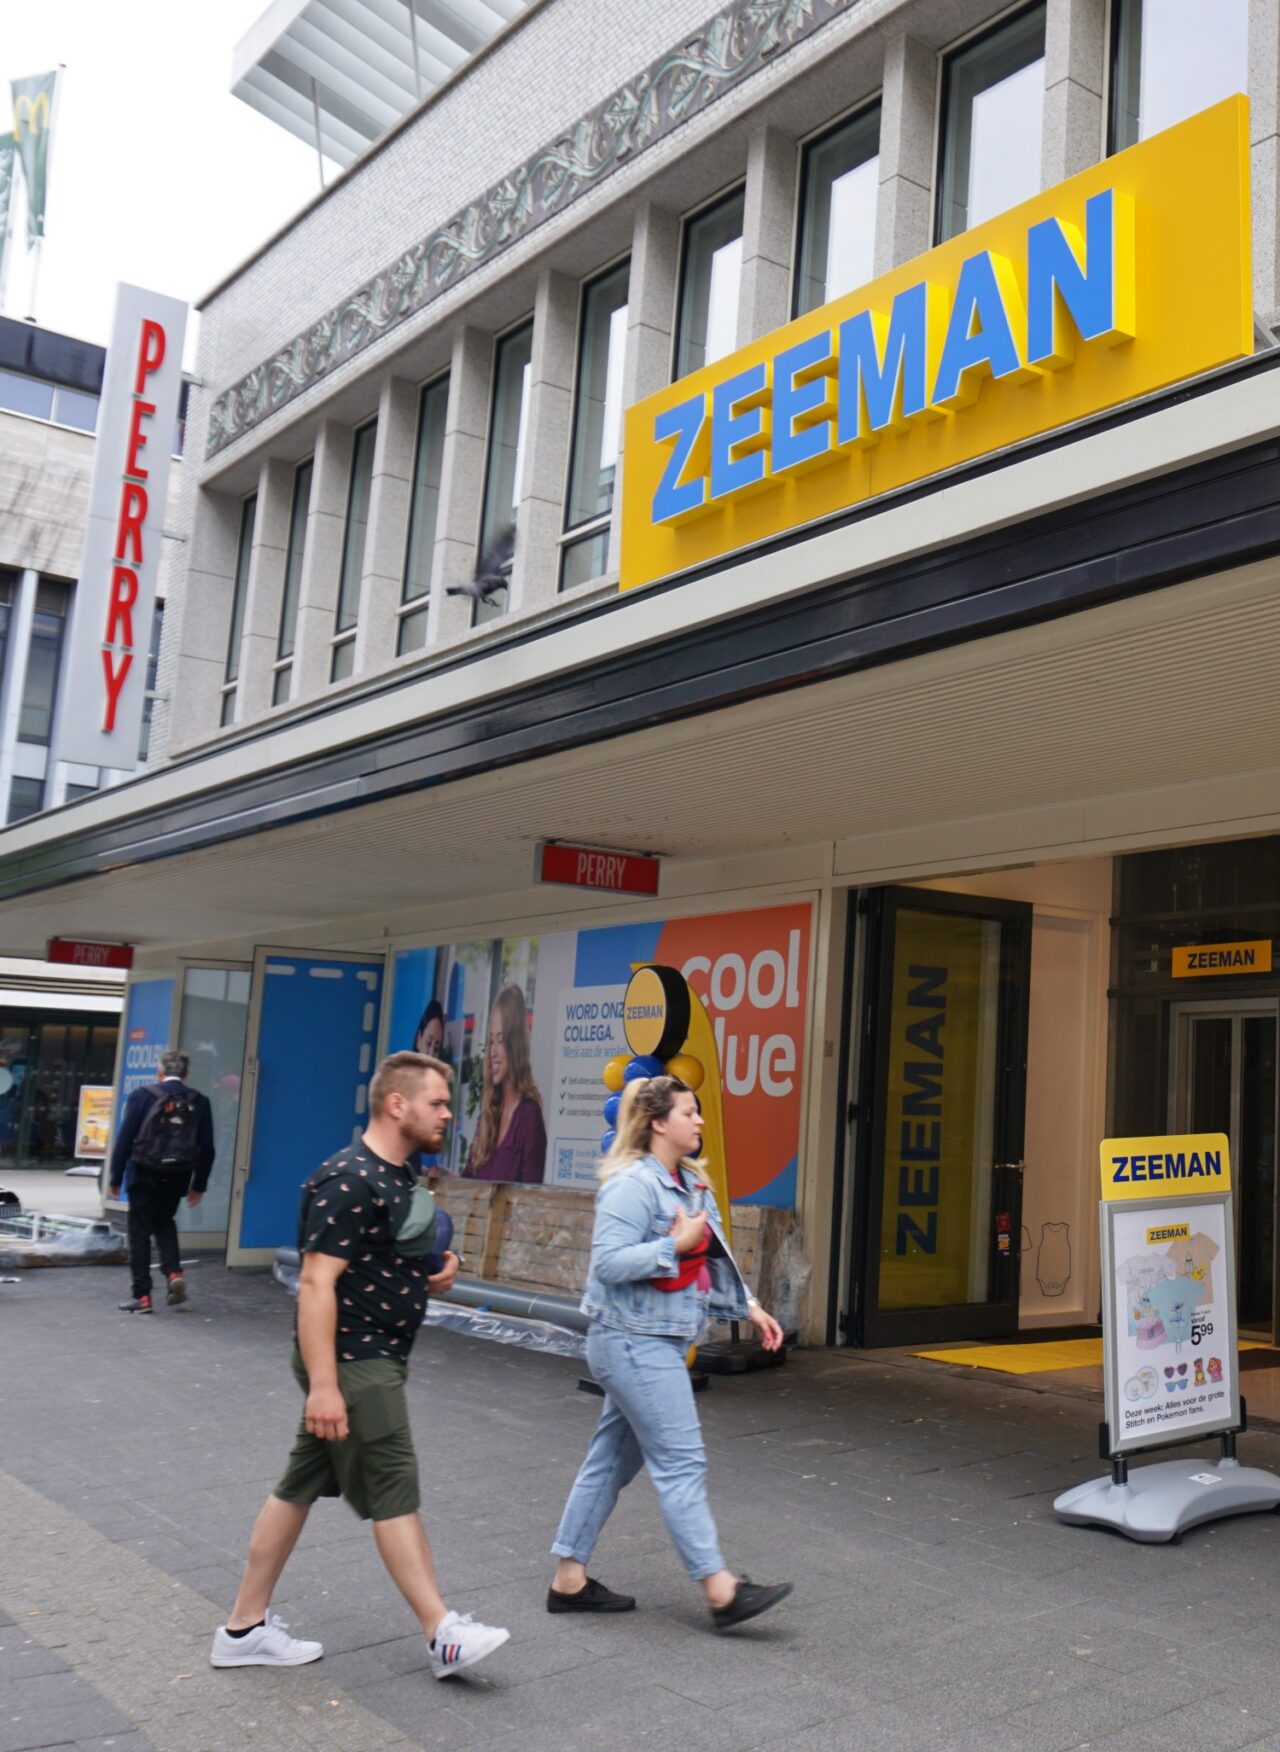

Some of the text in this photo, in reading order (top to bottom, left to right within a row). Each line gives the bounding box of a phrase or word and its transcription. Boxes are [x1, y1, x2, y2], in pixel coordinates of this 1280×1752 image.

[652, 188, 1117, 525] ZEEMAN
[101, 318, 167, 732] PERRY
[576, 852, 627, 889] PERRY
[73, 944, 111, 965] PERRY
[1187, 949, 1255, 970] ZEEMAN
[680, 929, 800, 1011] cool
[566, 1001, 625, 1020] WORD ONZ
[626, 1005, 664, 1020] ZEEMAN
[713, 1017, 796, 1098] lue
[896, 964, 948, 1256] ZEEMAN
[1112, 1151, 1221, 1183] ZEEMAN
[1149, 1227, 1187, 1241] ZEEMAN
[1125, 1391, 1225, 1419] Deze week: Alles voor de grote
[1125, 1404, 1205, 1429] Stitch en Pokemon fans.
